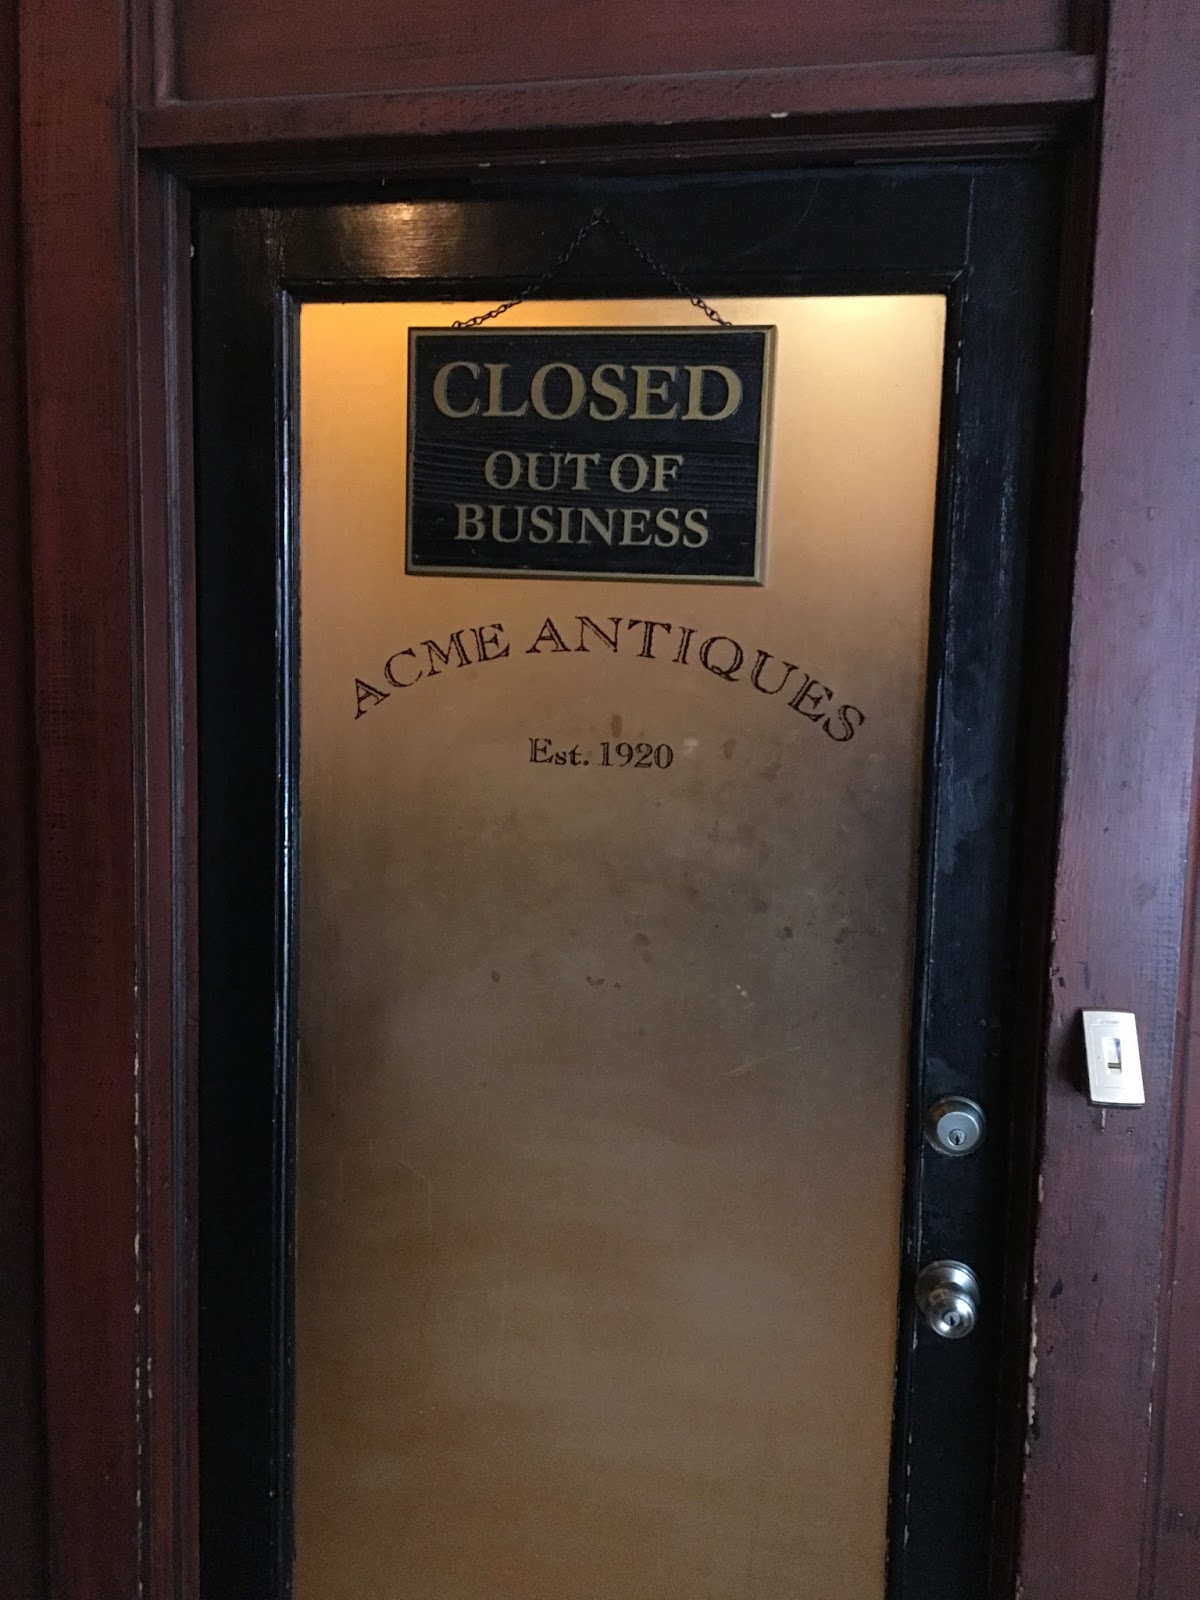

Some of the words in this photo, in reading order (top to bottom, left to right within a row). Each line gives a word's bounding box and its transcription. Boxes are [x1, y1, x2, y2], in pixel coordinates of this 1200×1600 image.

[432, 361, 743, 422] CLOSED
[484, 450, 600, 492] OUT
[609, 452, 684, 493] OF
[454, 503, 710, 549] BUSINESS
[354, 623, 510, 720] ACME
[525, 615, 866, 743] ANTIQUES
[528, 737, 590, 766] Est.
[600, 741, 674, 769] 1920
